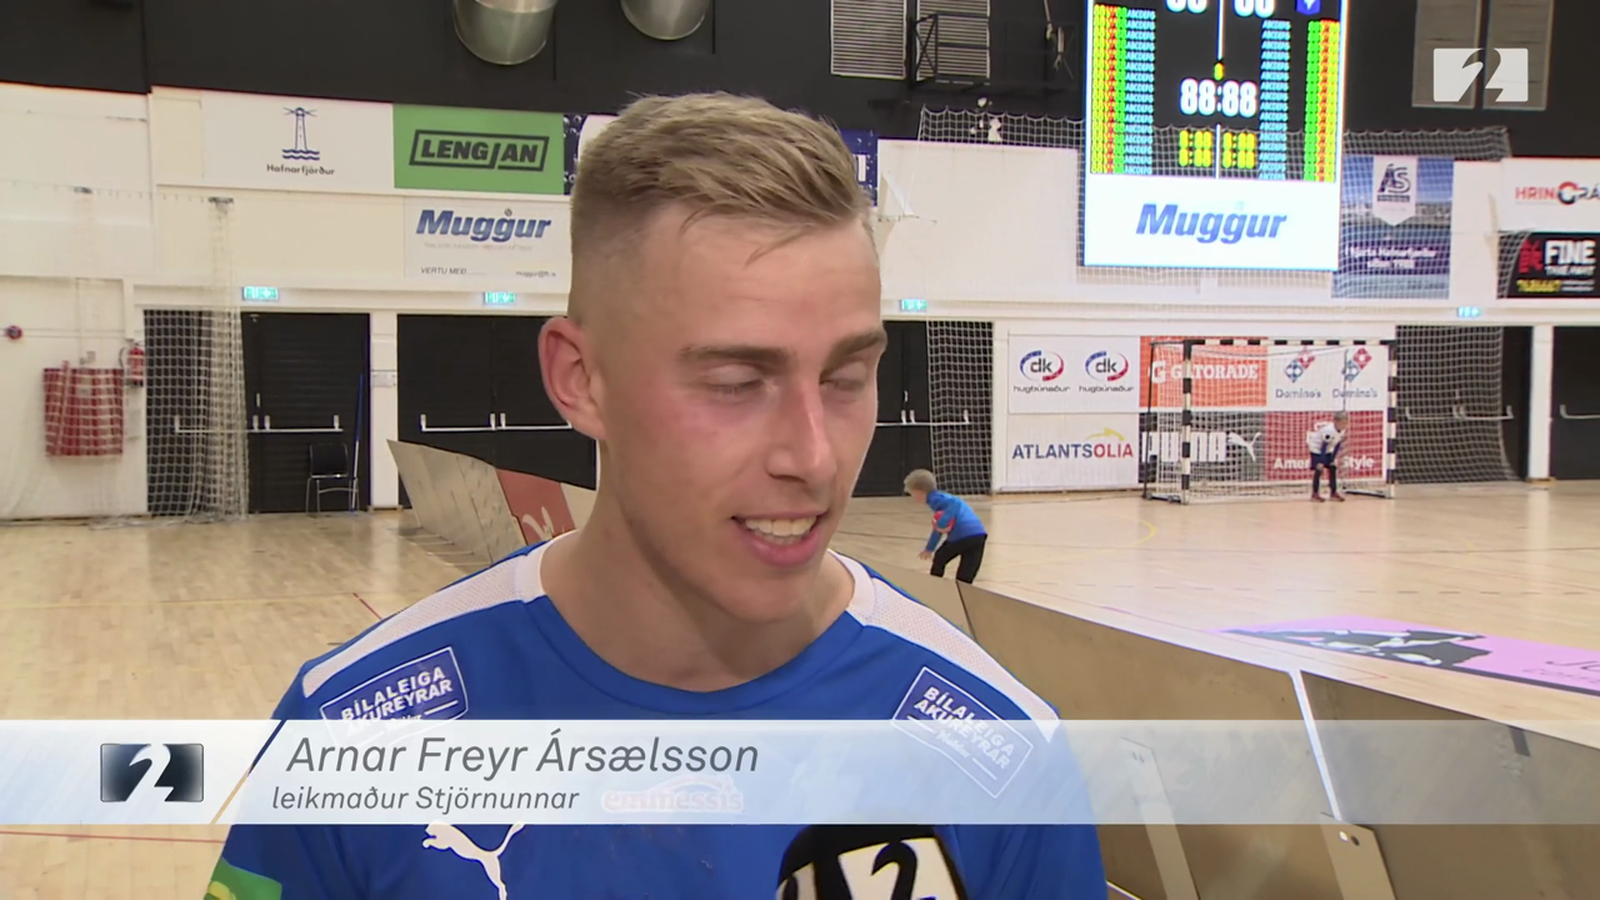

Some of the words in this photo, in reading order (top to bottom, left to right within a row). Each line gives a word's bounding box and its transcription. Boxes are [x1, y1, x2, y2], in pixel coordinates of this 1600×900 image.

[266, 163, 335, 176] Hafnarfjörður
[416, 209, 552, 243] Muggur
[1136, 203, 1287, 244] Muggur
[1545, 240, 1596, 265] FINE
[1030, 357, 1053, 374] dk
[1095, 357, 1118, 374] dk
[1170, 363, 1259, 380] GTORADE
[1013, 385, 1070, 394] hugbúnaður
[1079, 385, 1135, 394] hugbúnaður
